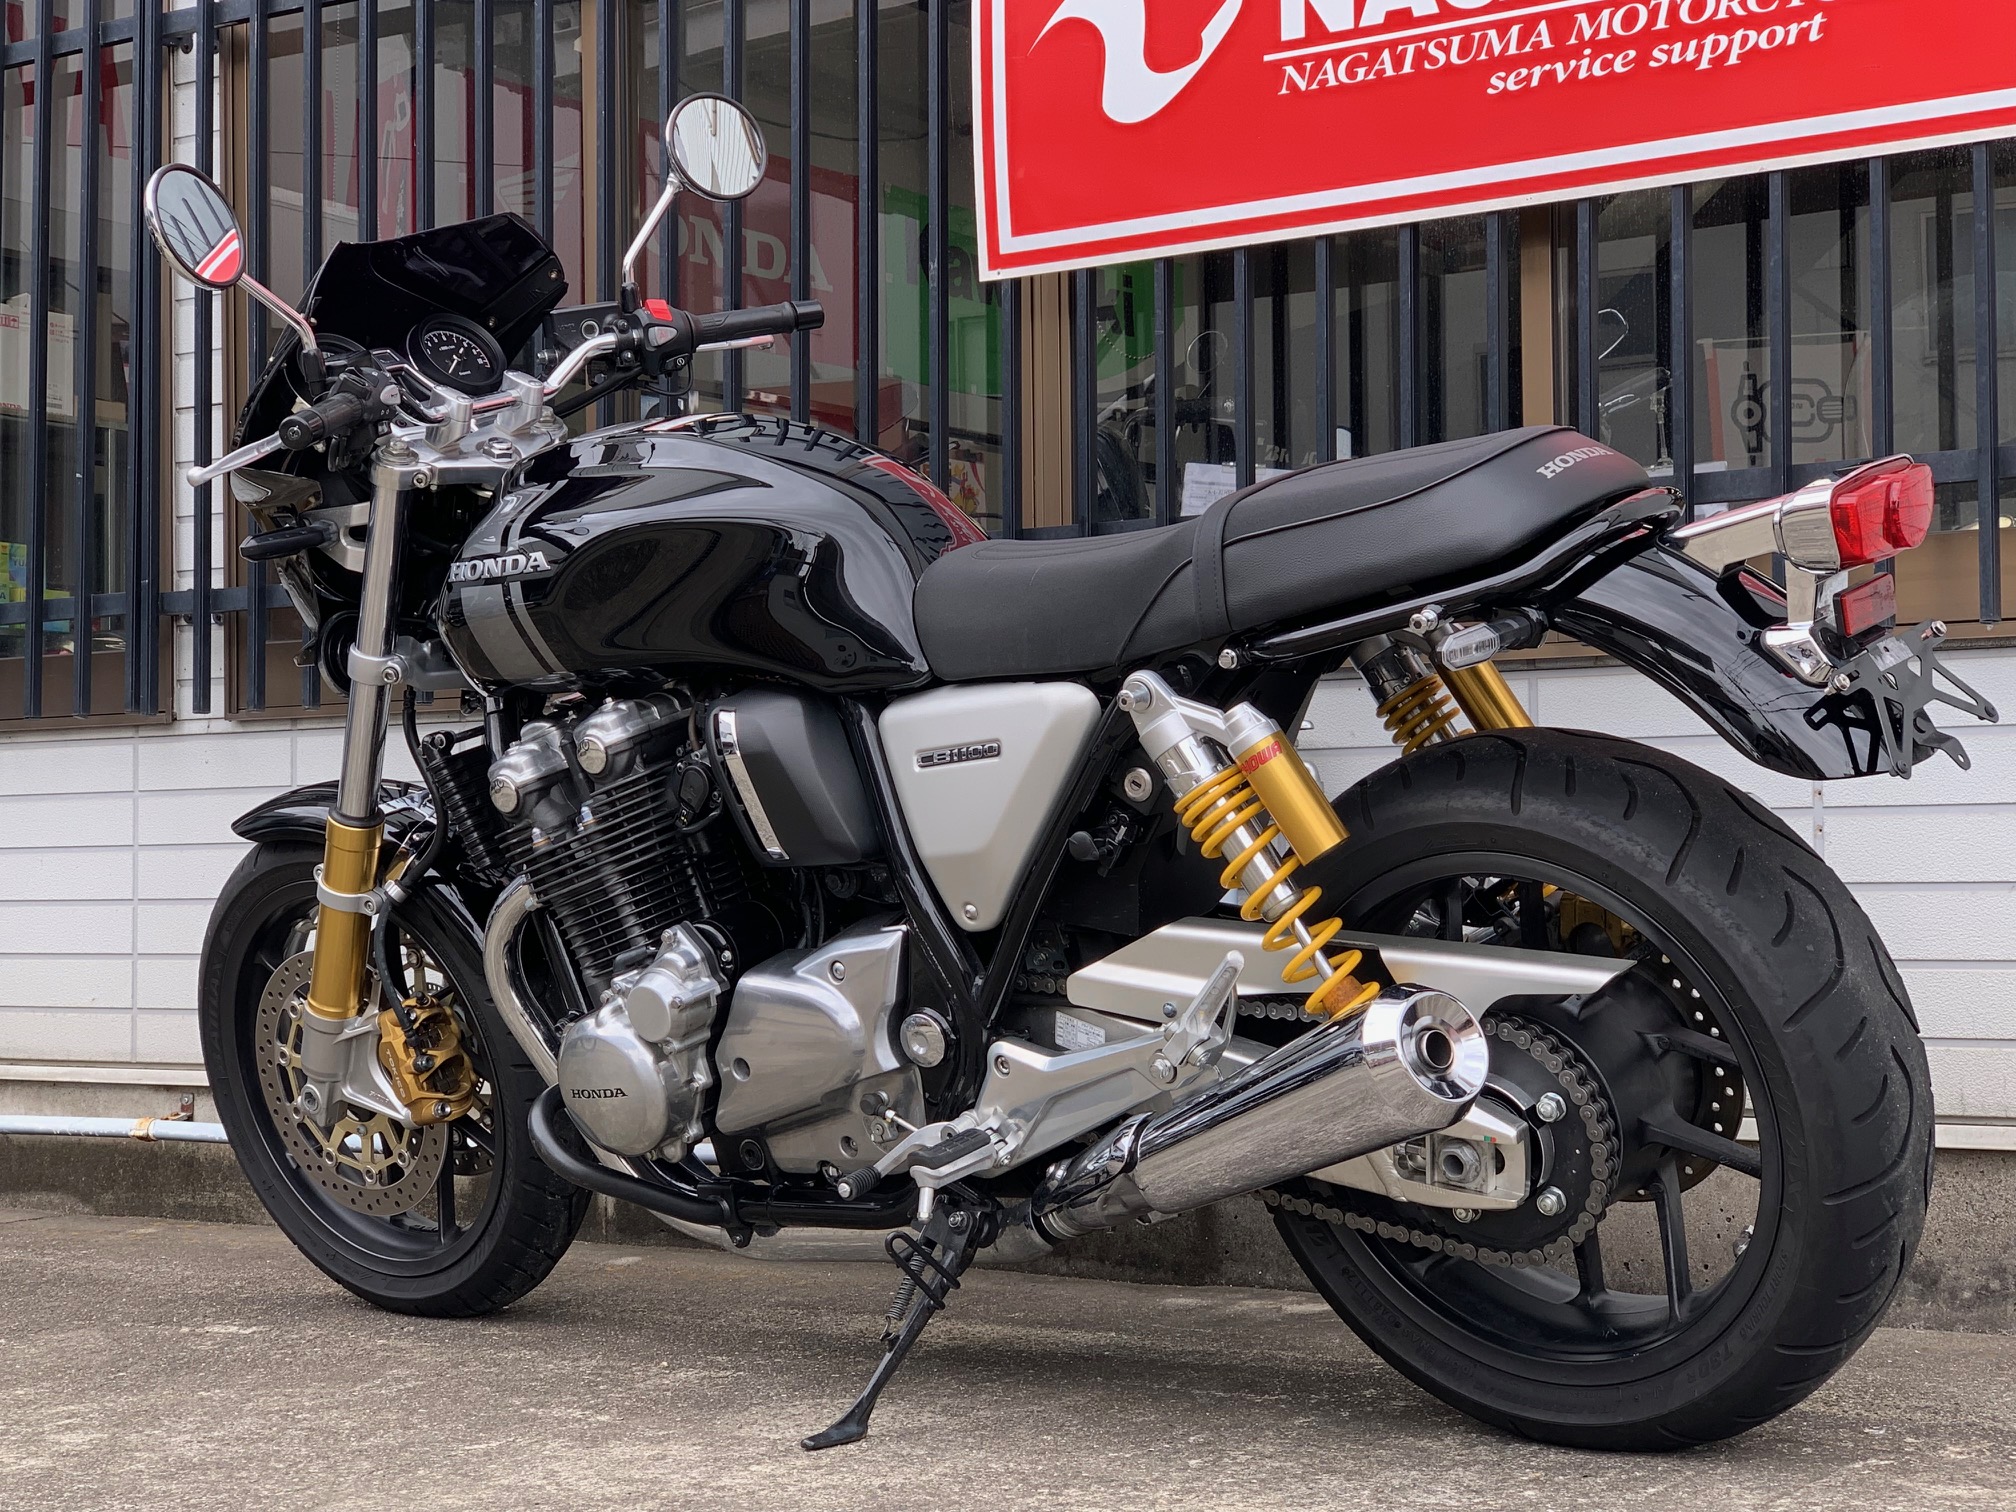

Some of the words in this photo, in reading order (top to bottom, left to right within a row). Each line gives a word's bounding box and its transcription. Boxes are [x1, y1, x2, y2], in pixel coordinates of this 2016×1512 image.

[1278, 19, 1555, 95] NAGATSUMA
[1565, 0, 1836, 45] MOTOR
[1487, 48, 1637, 95] service
[1649, 12, 1828, 71] support
[640, 207, 834, 292] ONDA
[1536, 446, 1614, 479] HONDA
[448, 551, 551, 582] HONDA
[916, 742, 1000, 768] CB1100
[386, 1048, 406, 1098] TOKICO
[570, 1087, 629, 1099] HONDA
